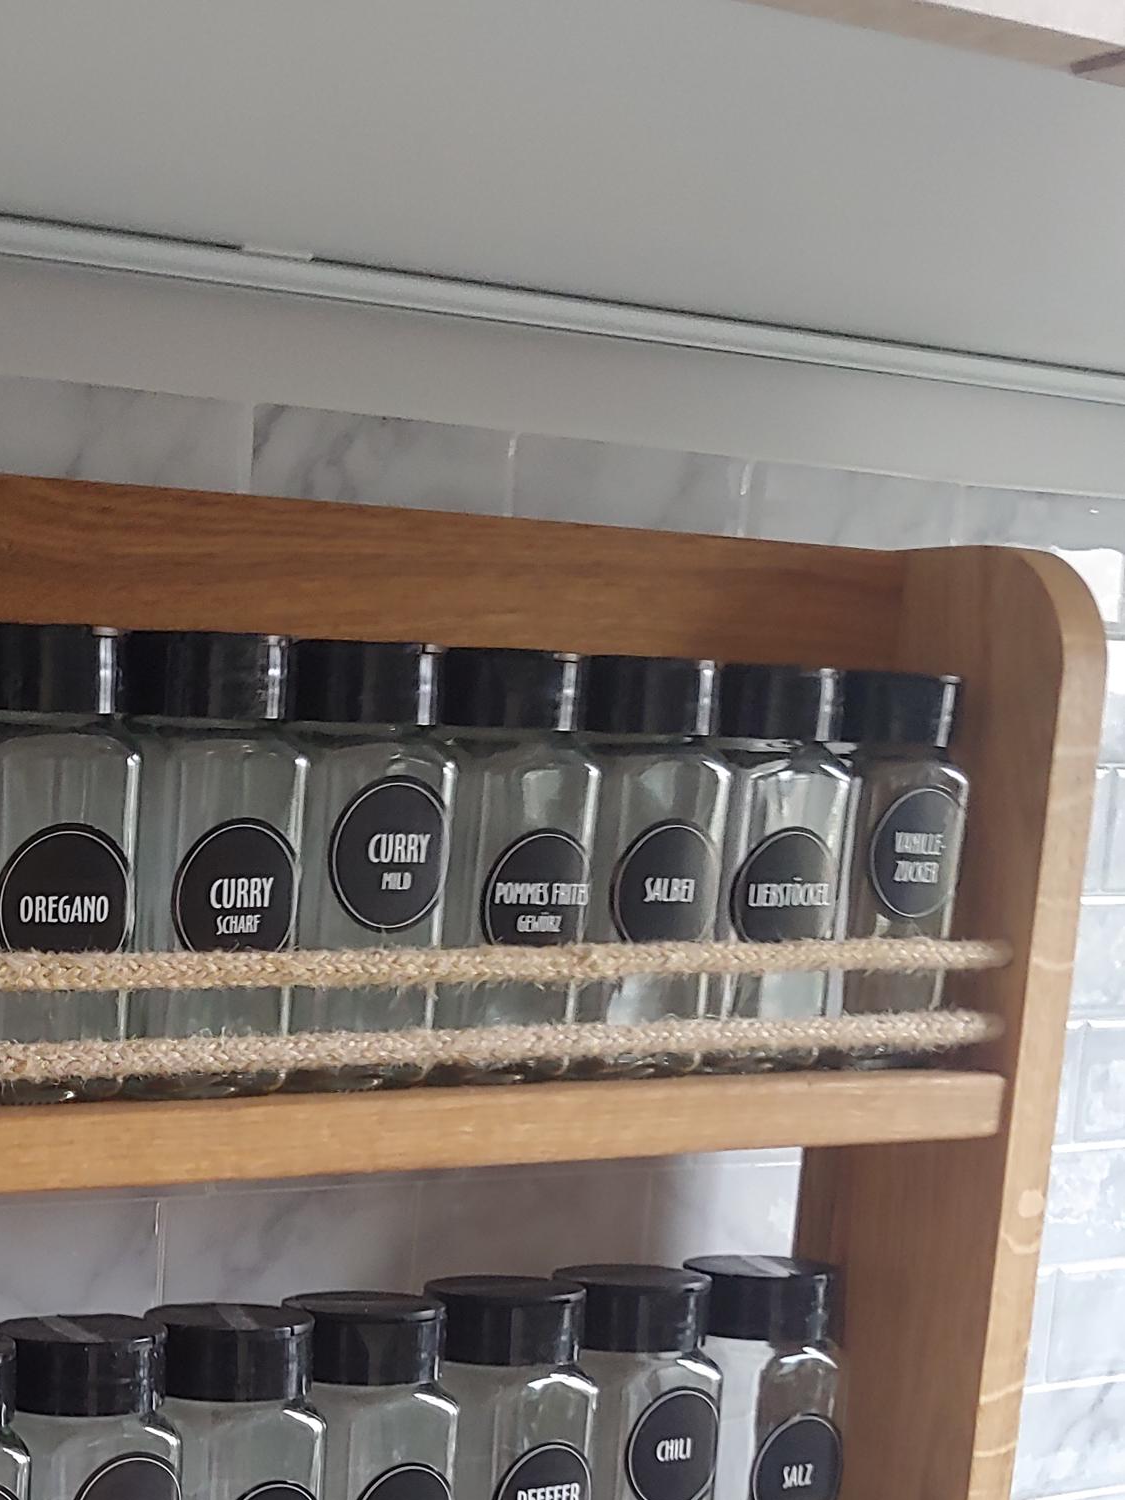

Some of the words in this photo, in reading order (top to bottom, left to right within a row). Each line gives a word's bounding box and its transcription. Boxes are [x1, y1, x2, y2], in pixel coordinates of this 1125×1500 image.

[368, 832, 432, 864] CURRY
[210, 877, 274, 909] CURRY
[381, 872, 412, 890] MILD
[494, 882, 550, 905] POMMES
[643, 877, 696, 903] SALBEI
[20, 895, 109, 924] OREGANO
[216, 914, 261, 935] SCHARF
[656, 1437, 692, 1463] CHILI
[782, 1463, 813, 1489] SALZ
